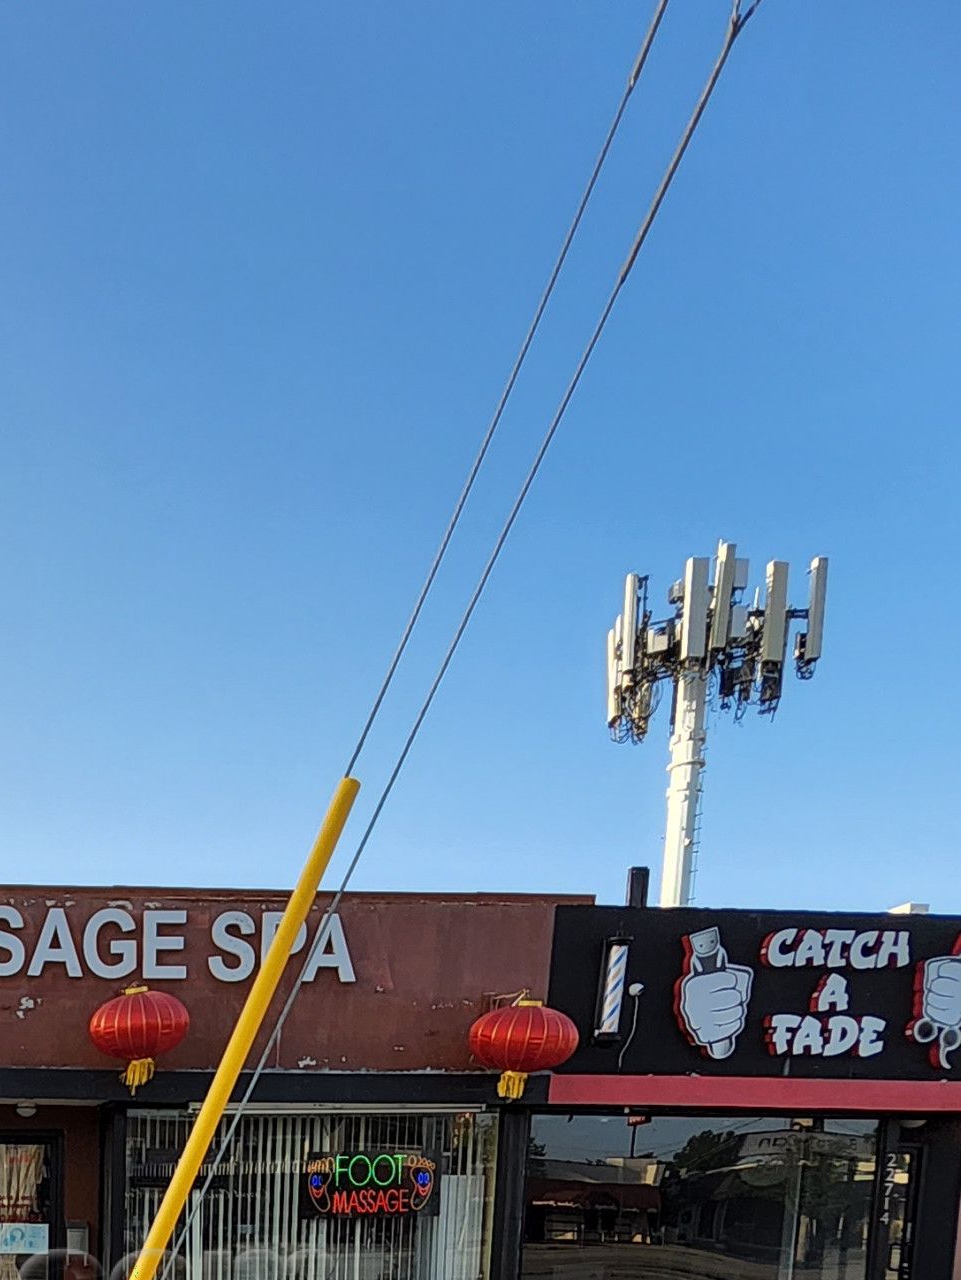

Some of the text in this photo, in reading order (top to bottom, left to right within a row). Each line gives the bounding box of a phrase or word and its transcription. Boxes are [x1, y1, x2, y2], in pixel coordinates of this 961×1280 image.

[208, 910, 357, 983] SPA
[767, 928, 911, 970] CATCH
[817, 972, 850, 1012] A
[770, 1013, 887, 1058] FADE
[335, 1153, 408, 1187] FOOT
[879, 1153, 897, 1226] 22714
[332, 1188, 410, 1214] MASSAGE
